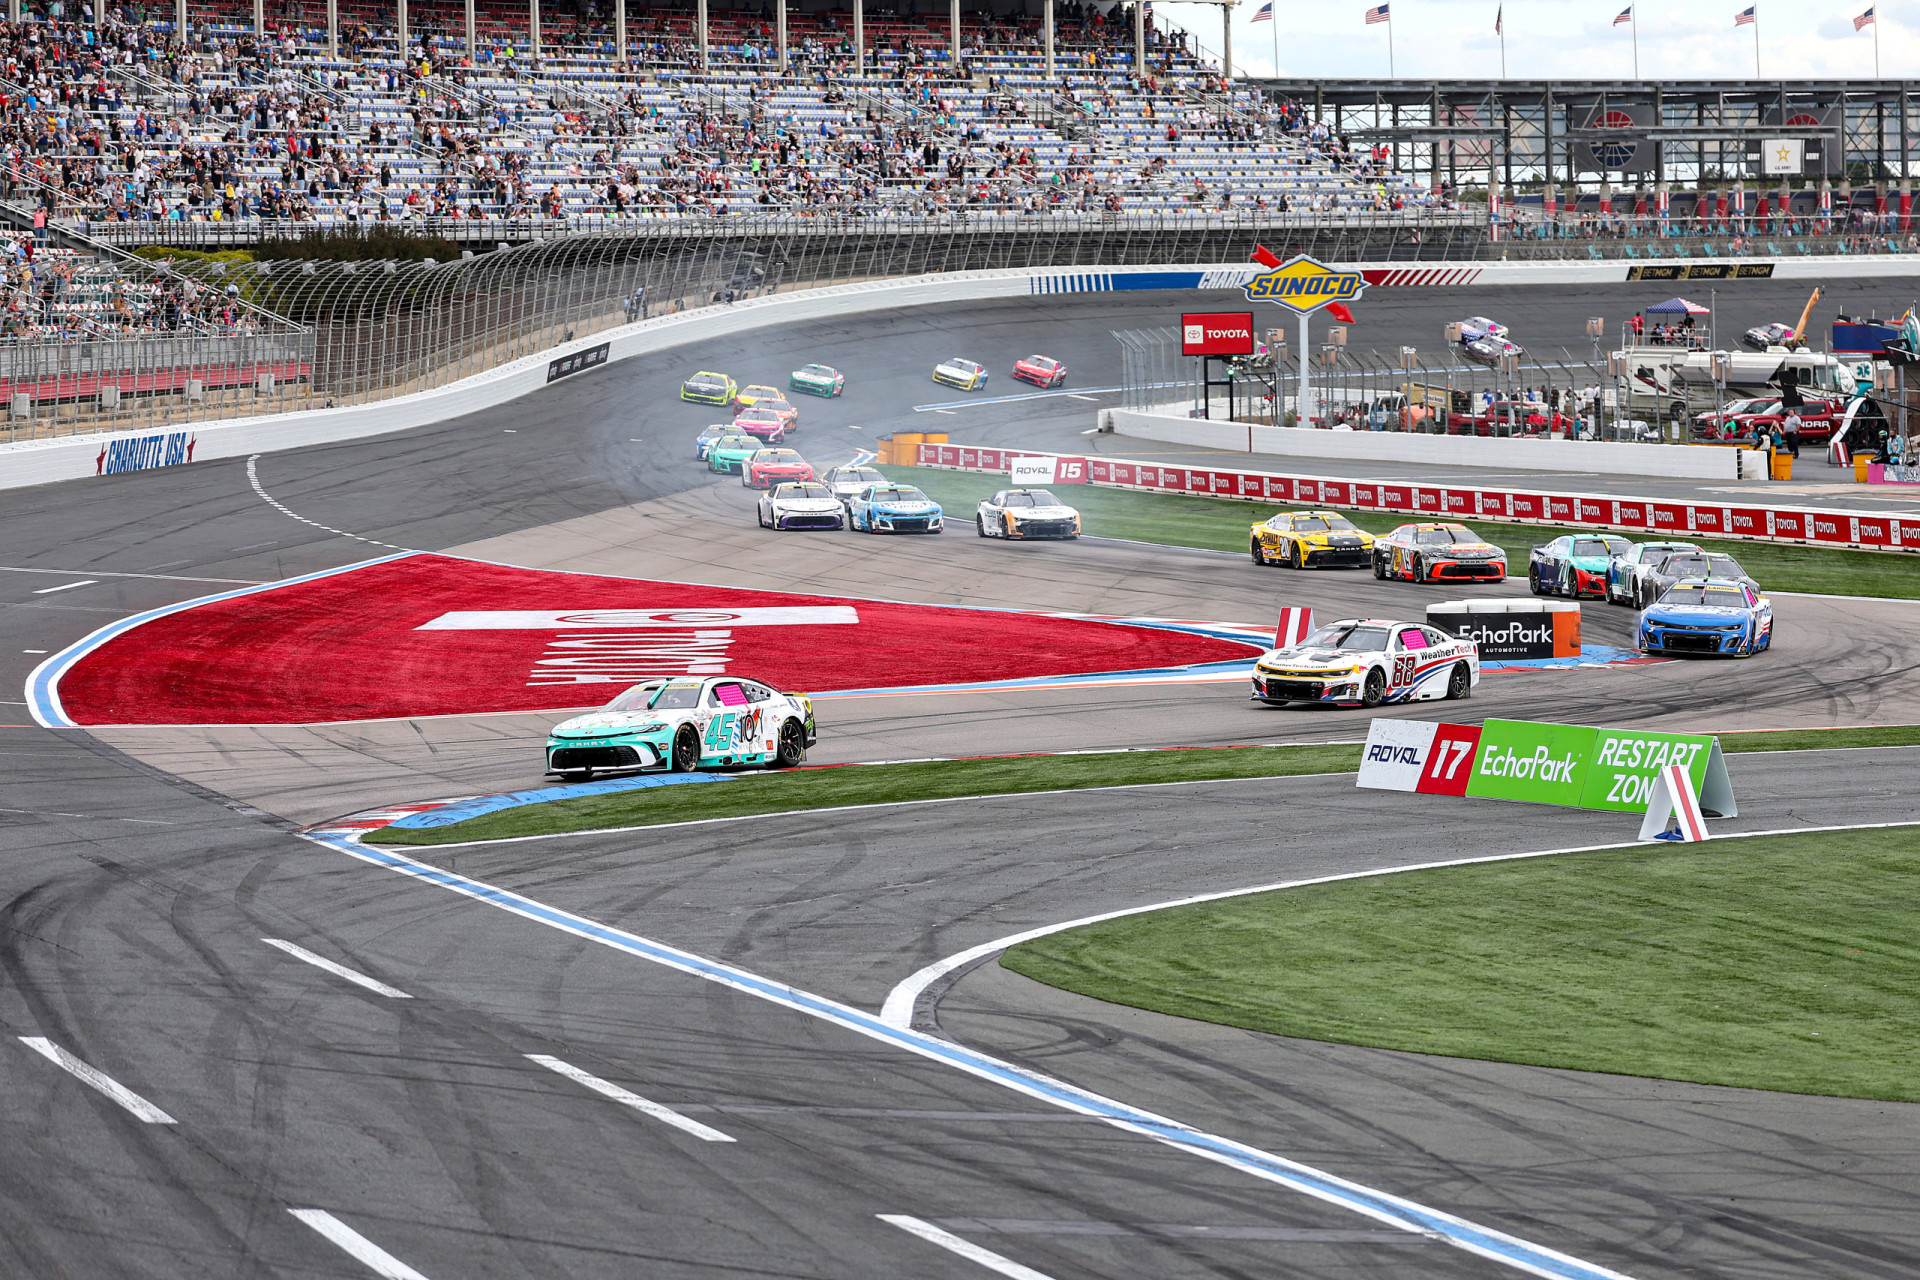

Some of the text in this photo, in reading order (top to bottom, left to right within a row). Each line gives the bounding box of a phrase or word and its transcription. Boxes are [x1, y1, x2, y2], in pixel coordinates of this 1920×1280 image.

[1642, 267, 1673, 277] BETMGM
[1690, 267, 1721, 277] BETMGM
[1738, 266, 1770, 276] BETMGM
[1198, 271, 1246, 288] CHARL
[1253, 276, 1357, 296] SUNOCO
[1206, 329, 1249, 339] TOYOTA
[106, 432, 187, 475] CHARLOTTE USA
[1016, 462, 1082, 479] ROVAL 15
[1244, 481, 1259, 490] TOYOTA
[1270, 483, 1284, 493] TOYOTA
[1300, 485, 1314, 495] TOYOTA
[1325, 487, 1340, 497] TOYOTA
[1356, 490, 1372, 500] TOYOTA
[1385, 492, 1401, 502] TOYOTA
[1420, 494, 1436, 504] TOYOTA
[1448, 496, 1464, 507] TOYOTA
[1483, 498, 1500, 509] TOYOTA
[1514, 500, 1532, 512] TOYOTA
[1551, 503, 1569, 514] TOYOTA
[1582, 504, 1600, 516] TOYOTA
[1621, 508, 1640, 519] TOYOTA
[1655, 510, 1674, 522] TOYOTA
[1696, 513, 1717, 525] TOYOTA
[1732, 515, 1753, 527] TOYOTA
[1776, 518, 1798, 530] TOYOTA
[1815, 521, 1837, 534] TOYOTA
[1860, 524, 1883, 537] TOYOTA
[1901, 527, 1920, 539] TOYOT
[1279, 536, 1290, 558] 20
[1401, 548, 1412, 570] 19
[1459, 622, 1553, 644] EchoPark
[526, 629, 737, 686] TOYOTA
[1420, 644, 1471, 660] WeatherTech
[1391, 654, 1416, 689] 88
[704, 713, 735, 751] 45
[1367, 739, 1473, 780] ROVAL 17
[1597, 738, 1703, 770] RESTART
[1480, 745, 1578, 783] EchoPark
[1606, 774, 1658, 804] ZON
